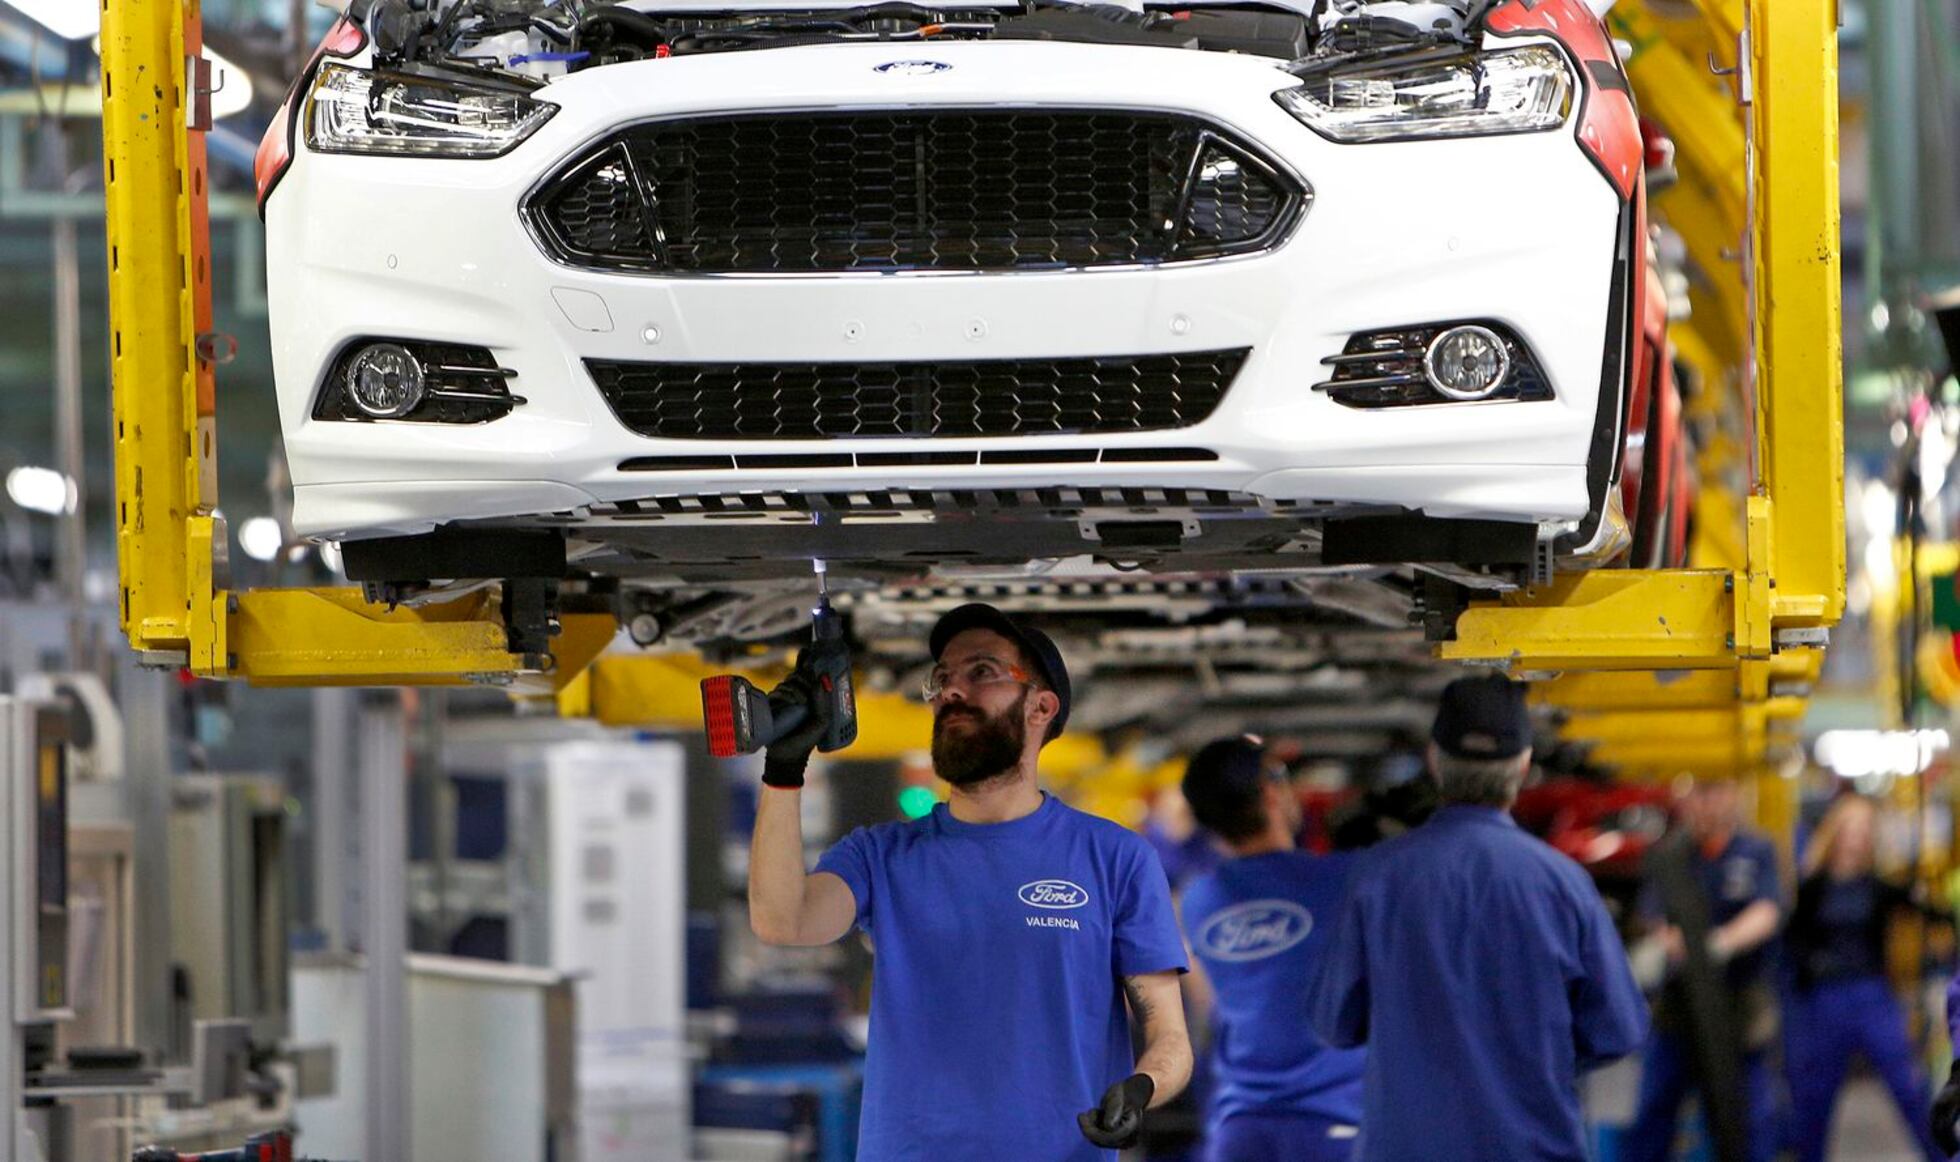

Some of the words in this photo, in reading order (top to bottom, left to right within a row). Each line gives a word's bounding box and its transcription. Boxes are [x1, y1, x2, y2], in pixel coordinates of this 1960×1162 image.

[1030, 884, 1077, 903] Ford
[1026, 917, 1080, 931] VALENCIA
[1213, 907, 1292, 952] Ford
